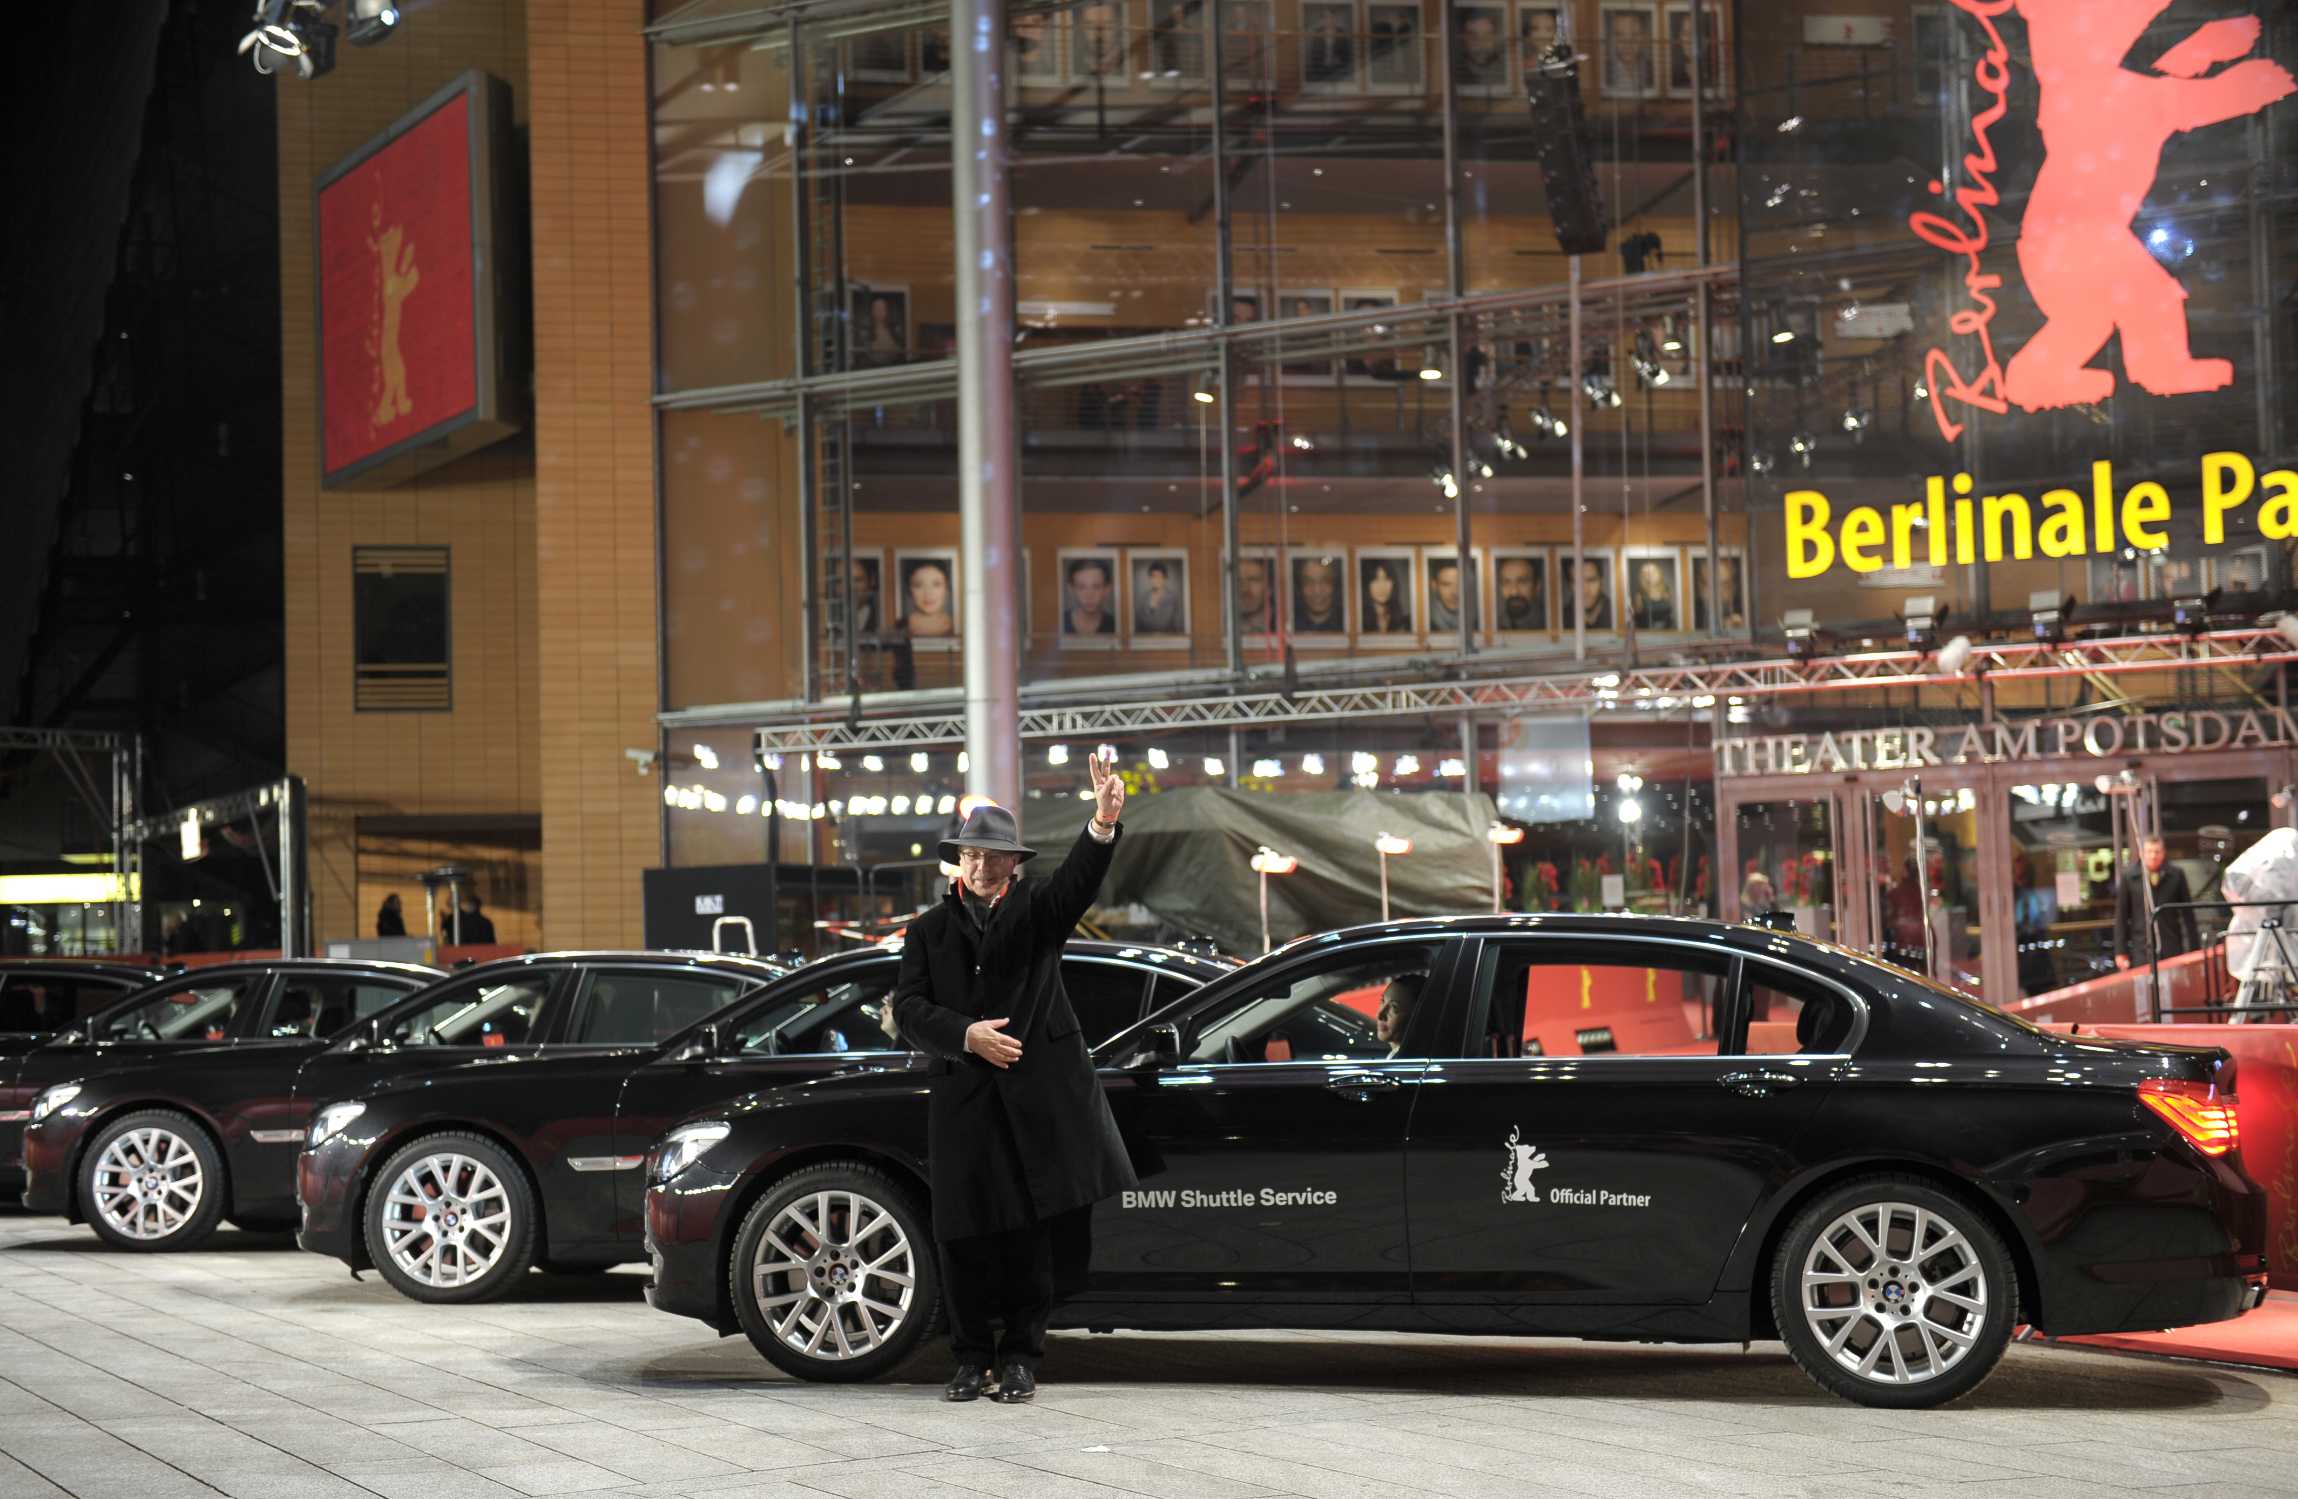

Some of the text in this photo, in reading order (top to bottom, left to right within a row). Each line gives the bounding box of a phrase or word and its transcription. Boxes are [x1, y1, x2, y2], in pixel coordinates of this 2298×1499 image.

[1784, 450, 2298, 579] Berlinale Pa
[1712, 726, 1942, 776] THEATER
[1952, 718, 2041, 764] AM
[1500, 1124, 1520, 1204] Berlinale
[1122, 1187, 1337, 1208] BMW Shuttle Service
[1550, 1187, 1651, 1207] Official Partner
